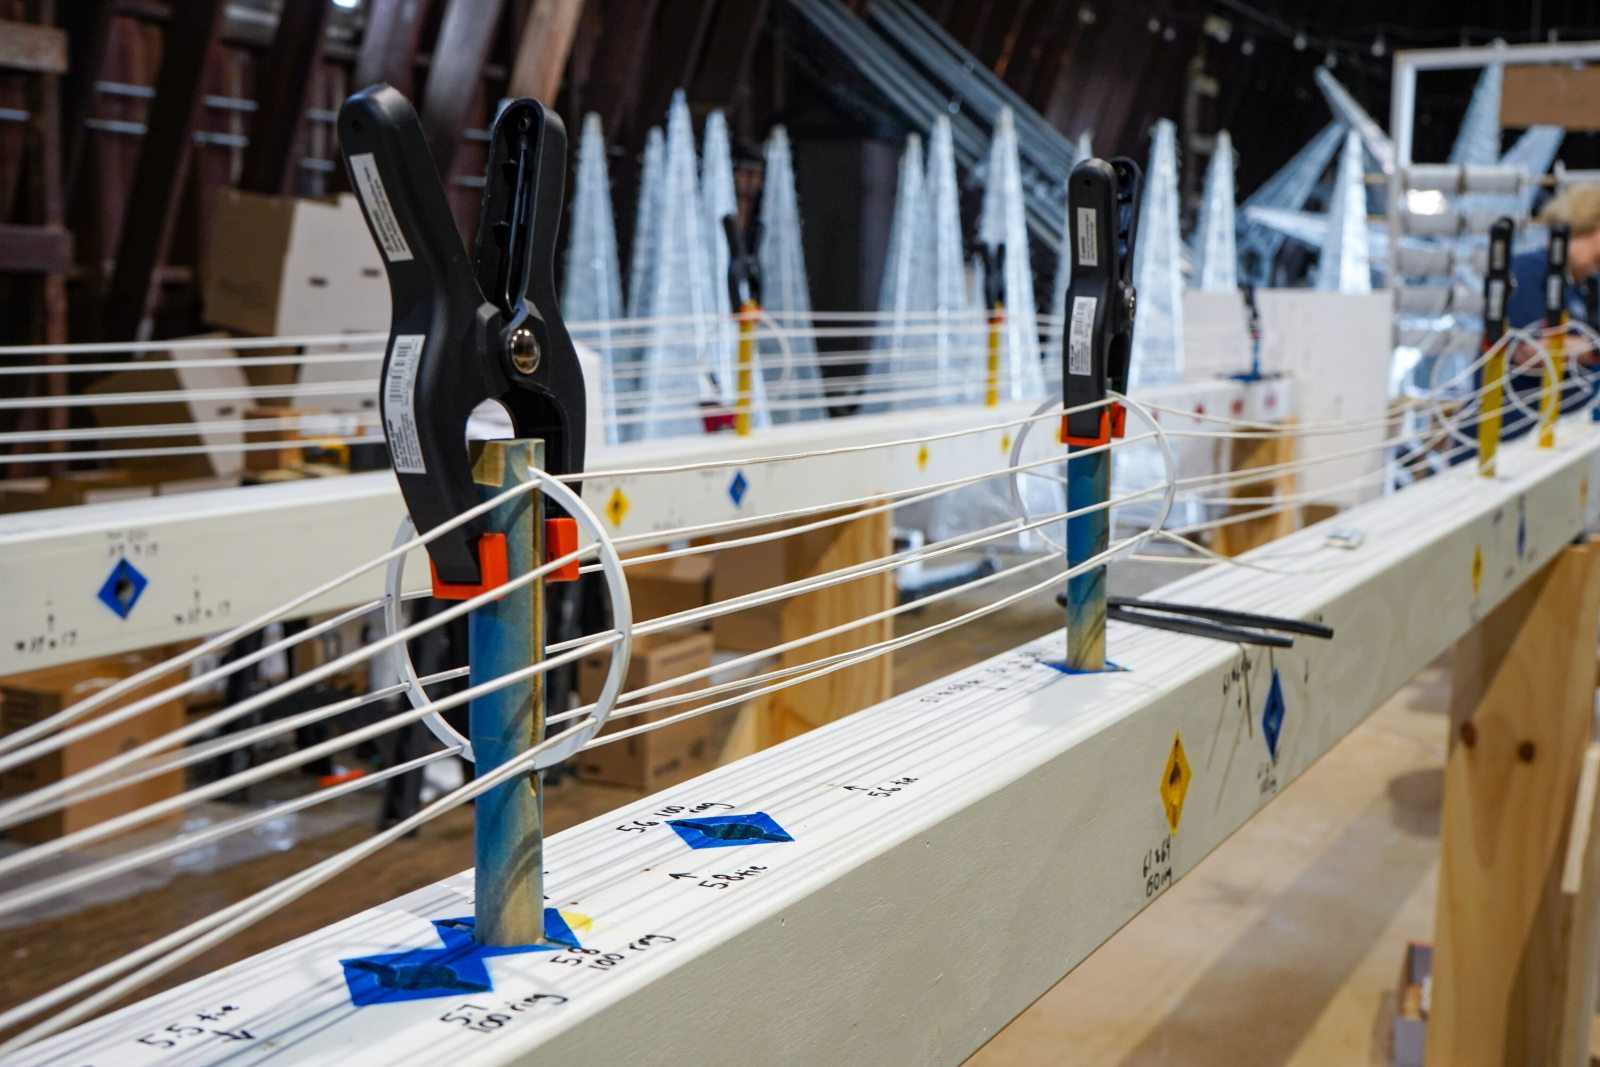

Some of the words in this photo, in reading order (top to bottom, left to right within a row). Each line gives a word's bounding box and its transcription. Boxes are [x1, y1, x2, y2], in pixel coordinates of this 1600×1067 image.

[588, 953, 625, 971] 100
[469, 1013, 512, 1033] 100
[504, 994, 569, 1013] ring
